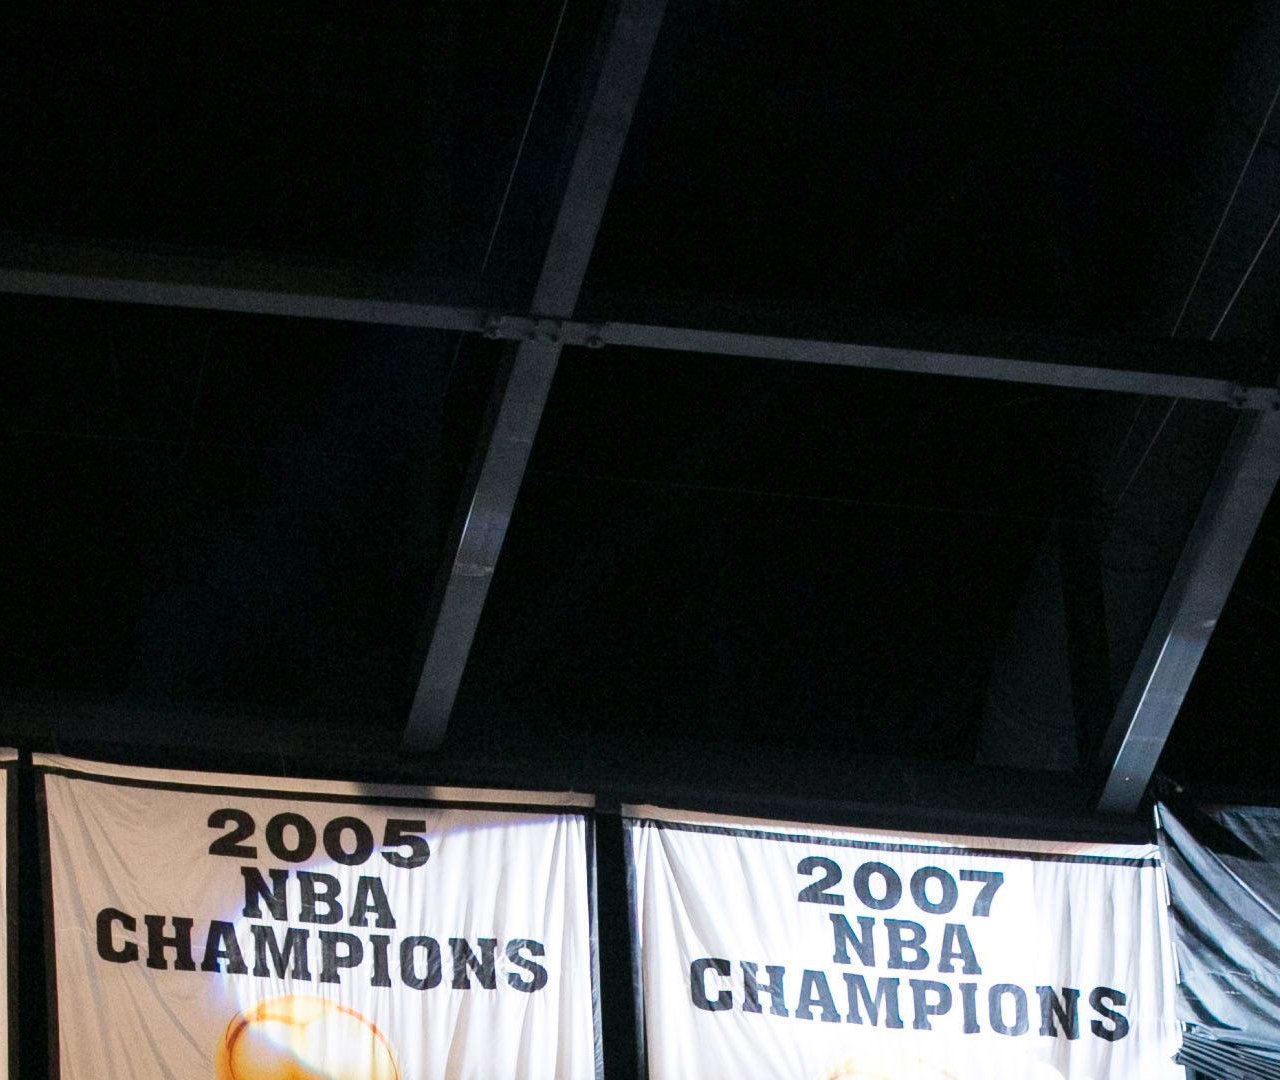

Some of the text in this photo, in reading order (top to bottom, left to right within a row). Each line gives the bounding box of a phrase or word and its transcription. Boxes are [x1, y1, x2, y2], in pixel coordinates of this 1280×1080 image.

[207, 808, 430, 869] 2005
[240, 867, 396, 930] NBA
[796, 856, 1005, 918] 2007
[96, 908, 548, 993] CHAMPIONS
[830, 911, 983, 976] NBA
[690, 957, 1130, 1043] CHAMPIONS
